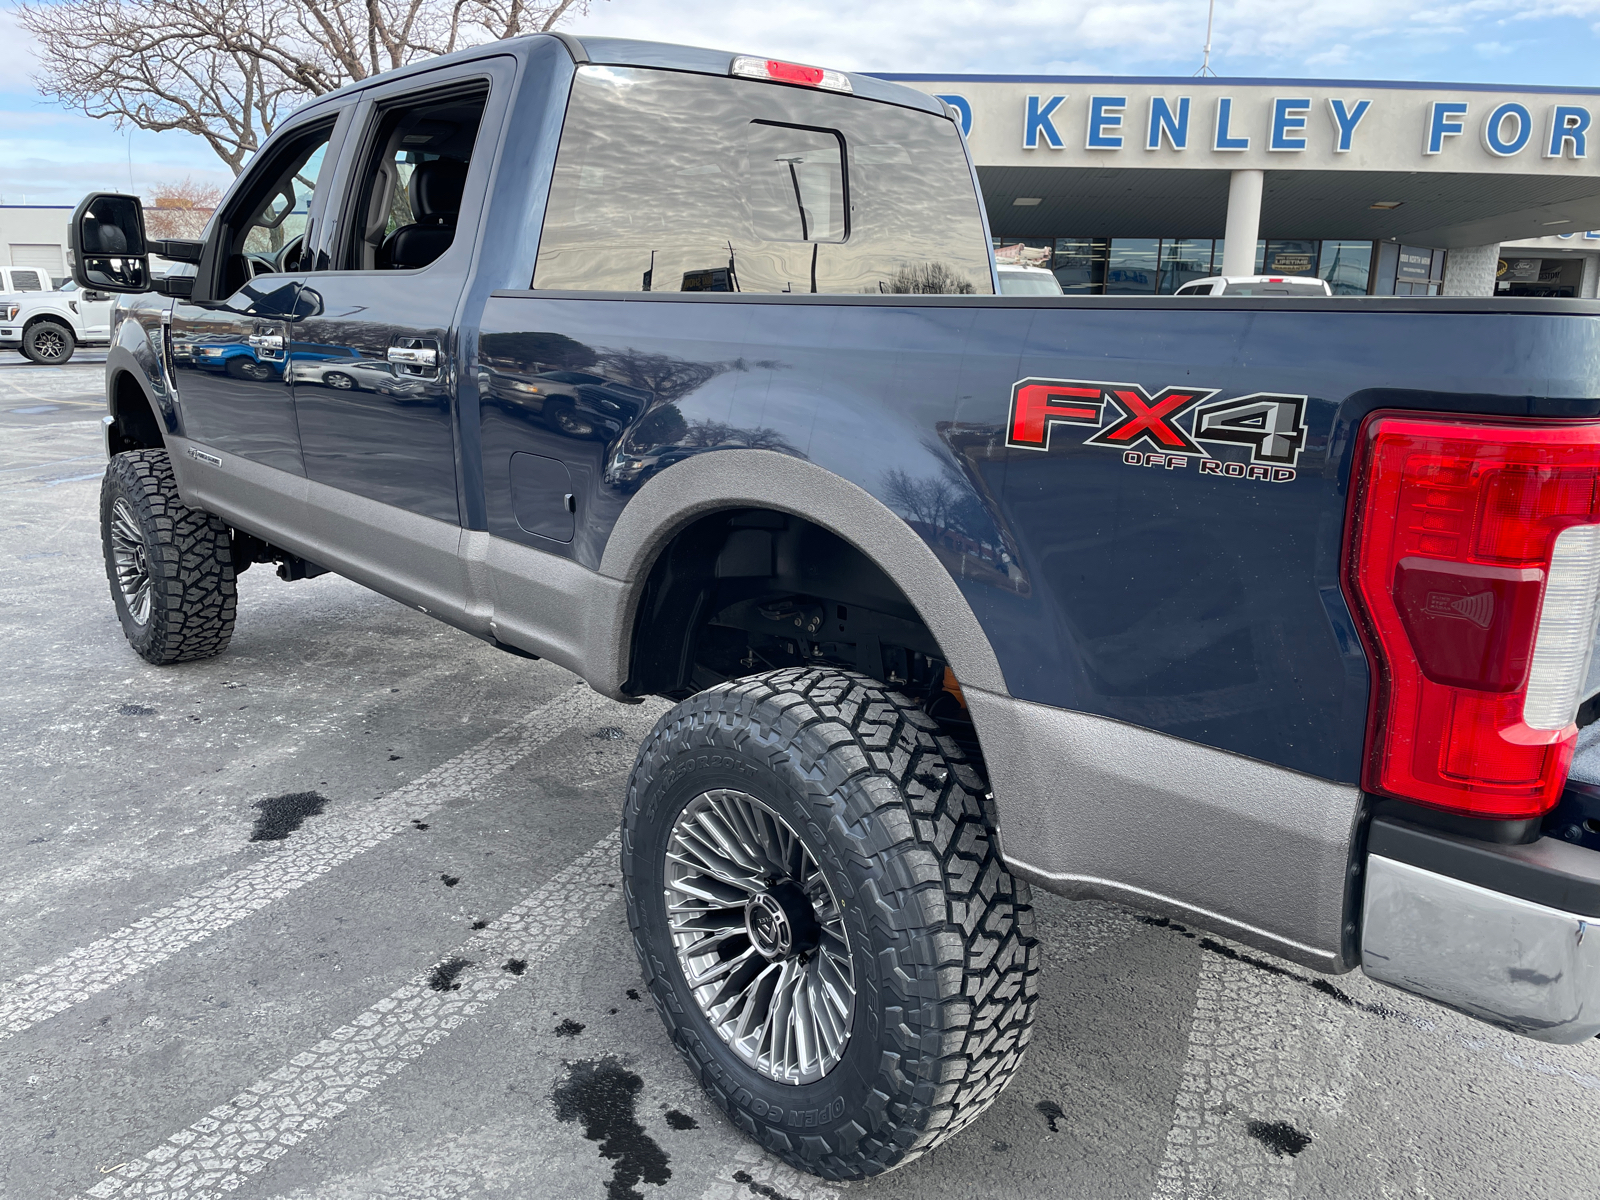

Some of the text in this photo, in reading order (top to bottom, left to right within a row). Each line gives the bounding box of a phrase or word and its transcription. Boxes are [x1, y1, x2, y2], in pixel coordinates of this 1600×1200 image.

[1022, 93, 1374, 153] KENLEY
[1422, 101, 1592, 159] FOR
[1005, 376, 1308, 468] FX4
[1122, 450, 1297, 483] OFF ROAD
[793, 800, 855, 899] TOYO
[682, 1026, 784, 1123] COUNTRY
[788, 1095, 845, 1128] OPEN
